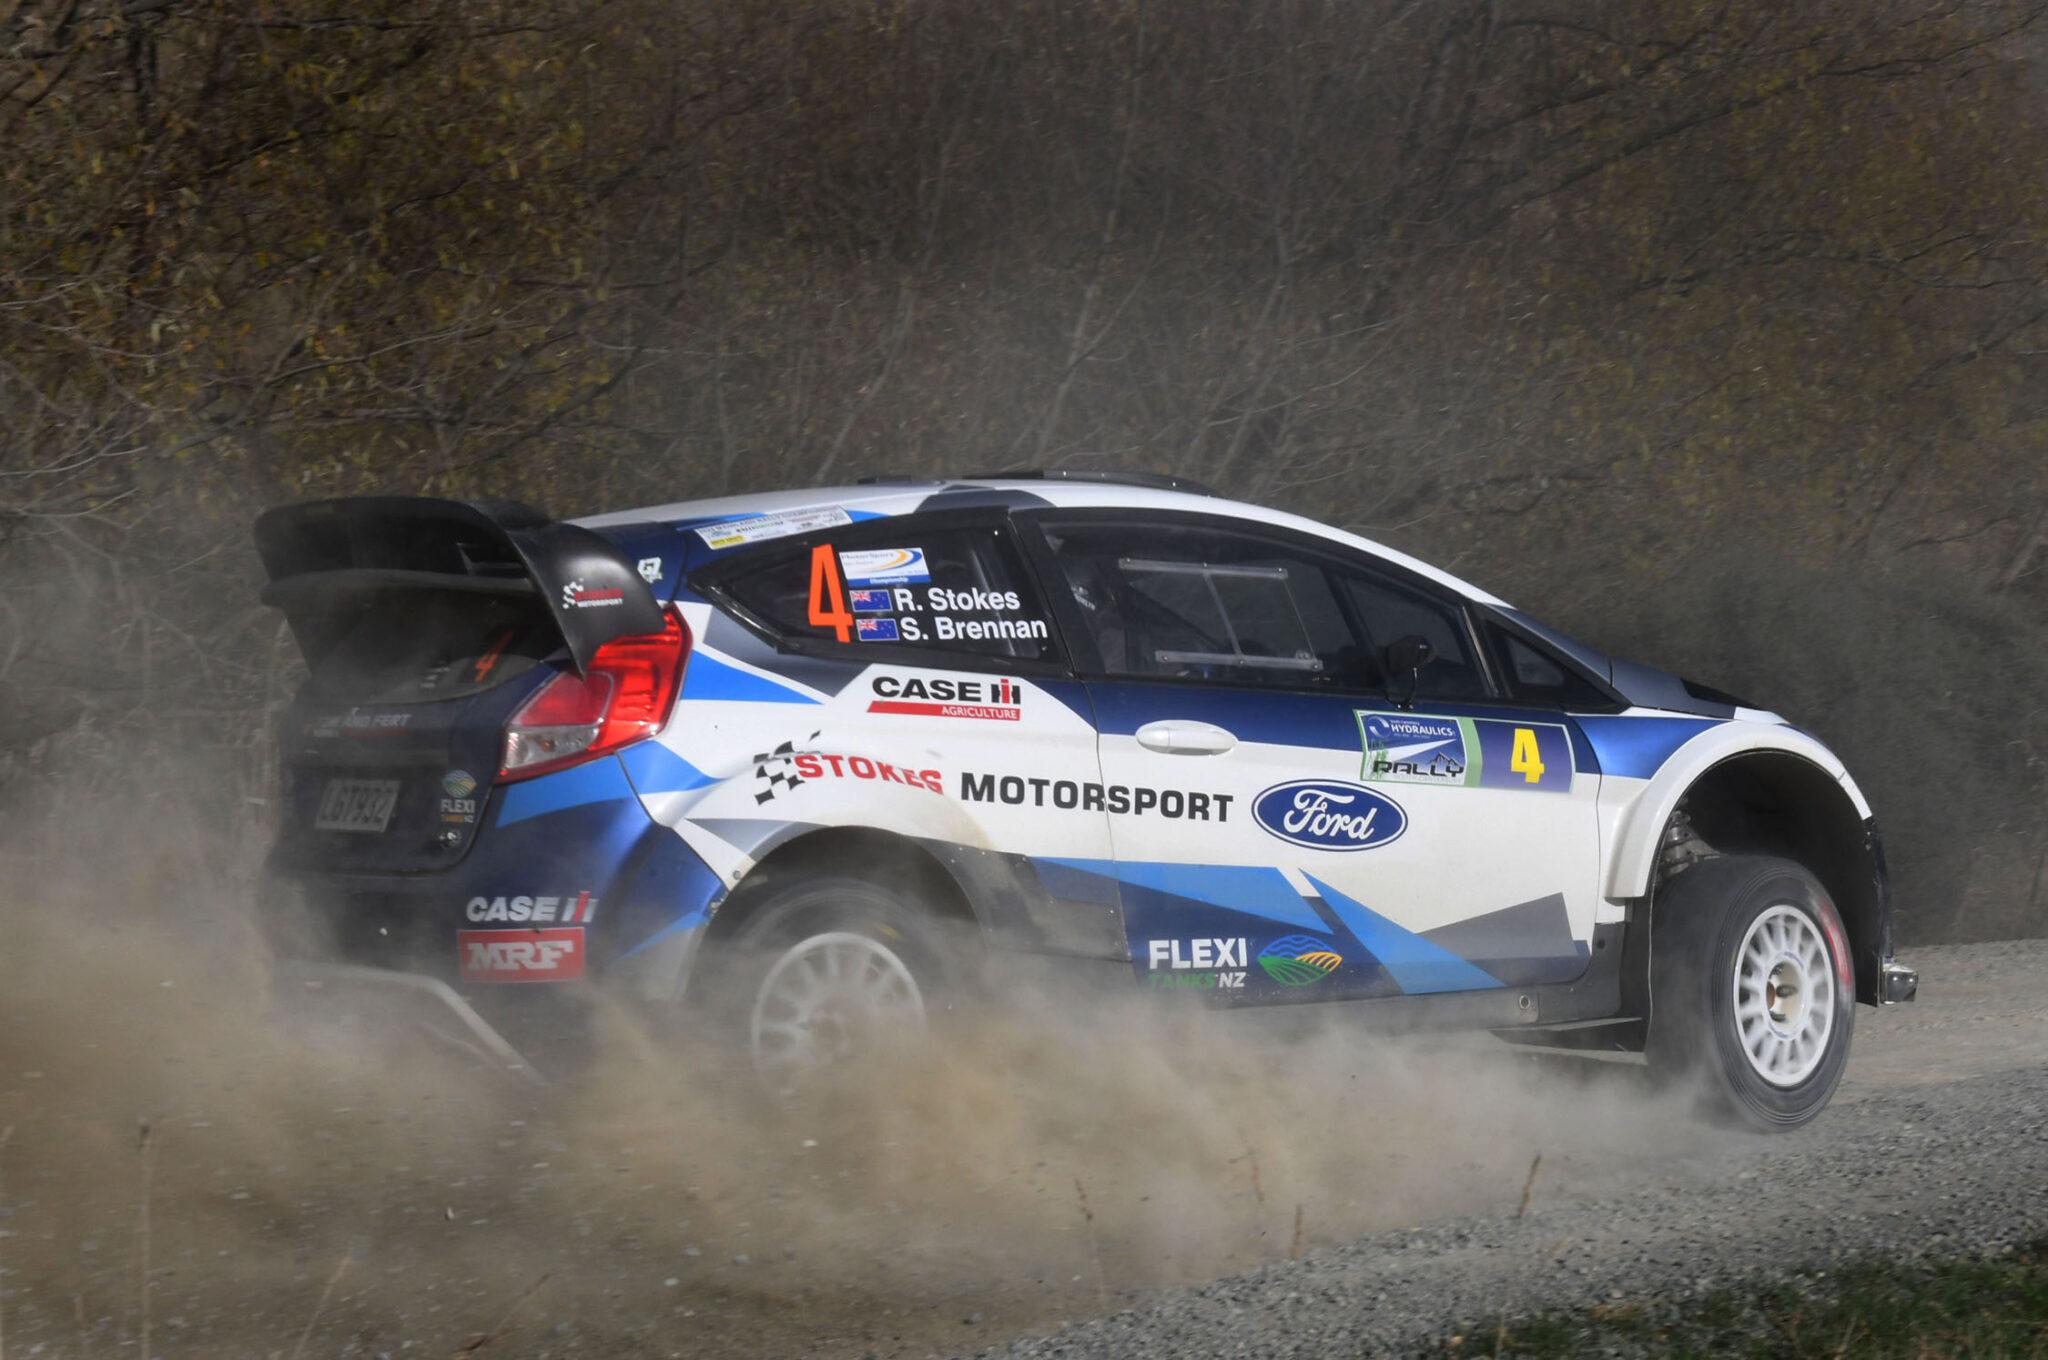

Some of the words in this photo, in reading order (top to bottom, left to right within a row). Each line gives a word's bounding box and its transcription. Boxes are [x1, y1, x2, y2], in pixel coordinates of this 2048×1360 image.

[808, 544, 853, 642] 4
[893, 588, 923, 612] R.
[927, 587, 1021, 612] Stokes
[900, 616, 929, 641] S.
[934, 616, 1048, 641] Brennan
[872, 676, 982, 702] CASE
[941, 706, 1018, 720] AGRICULTURE
[1390, 723, 1454, 737] HYDRAULICS
[1372, 759, 1465, 778] RALLY
[1511, 728, 1546, 784] 4
[795, 753, 944, 796] STOKES
[960, 771, 1234, 823] MOTORSPORT
[440, 798, 476, 813] FLEXI
[1283, 788, 1378, 841] Ford
[466, 895, 561, 923] CASE
[466, 940, 574, 971] MRF
[1148, 936, 1248, 970] FLEXI
[1218, 971, 1247, 988] NZ
